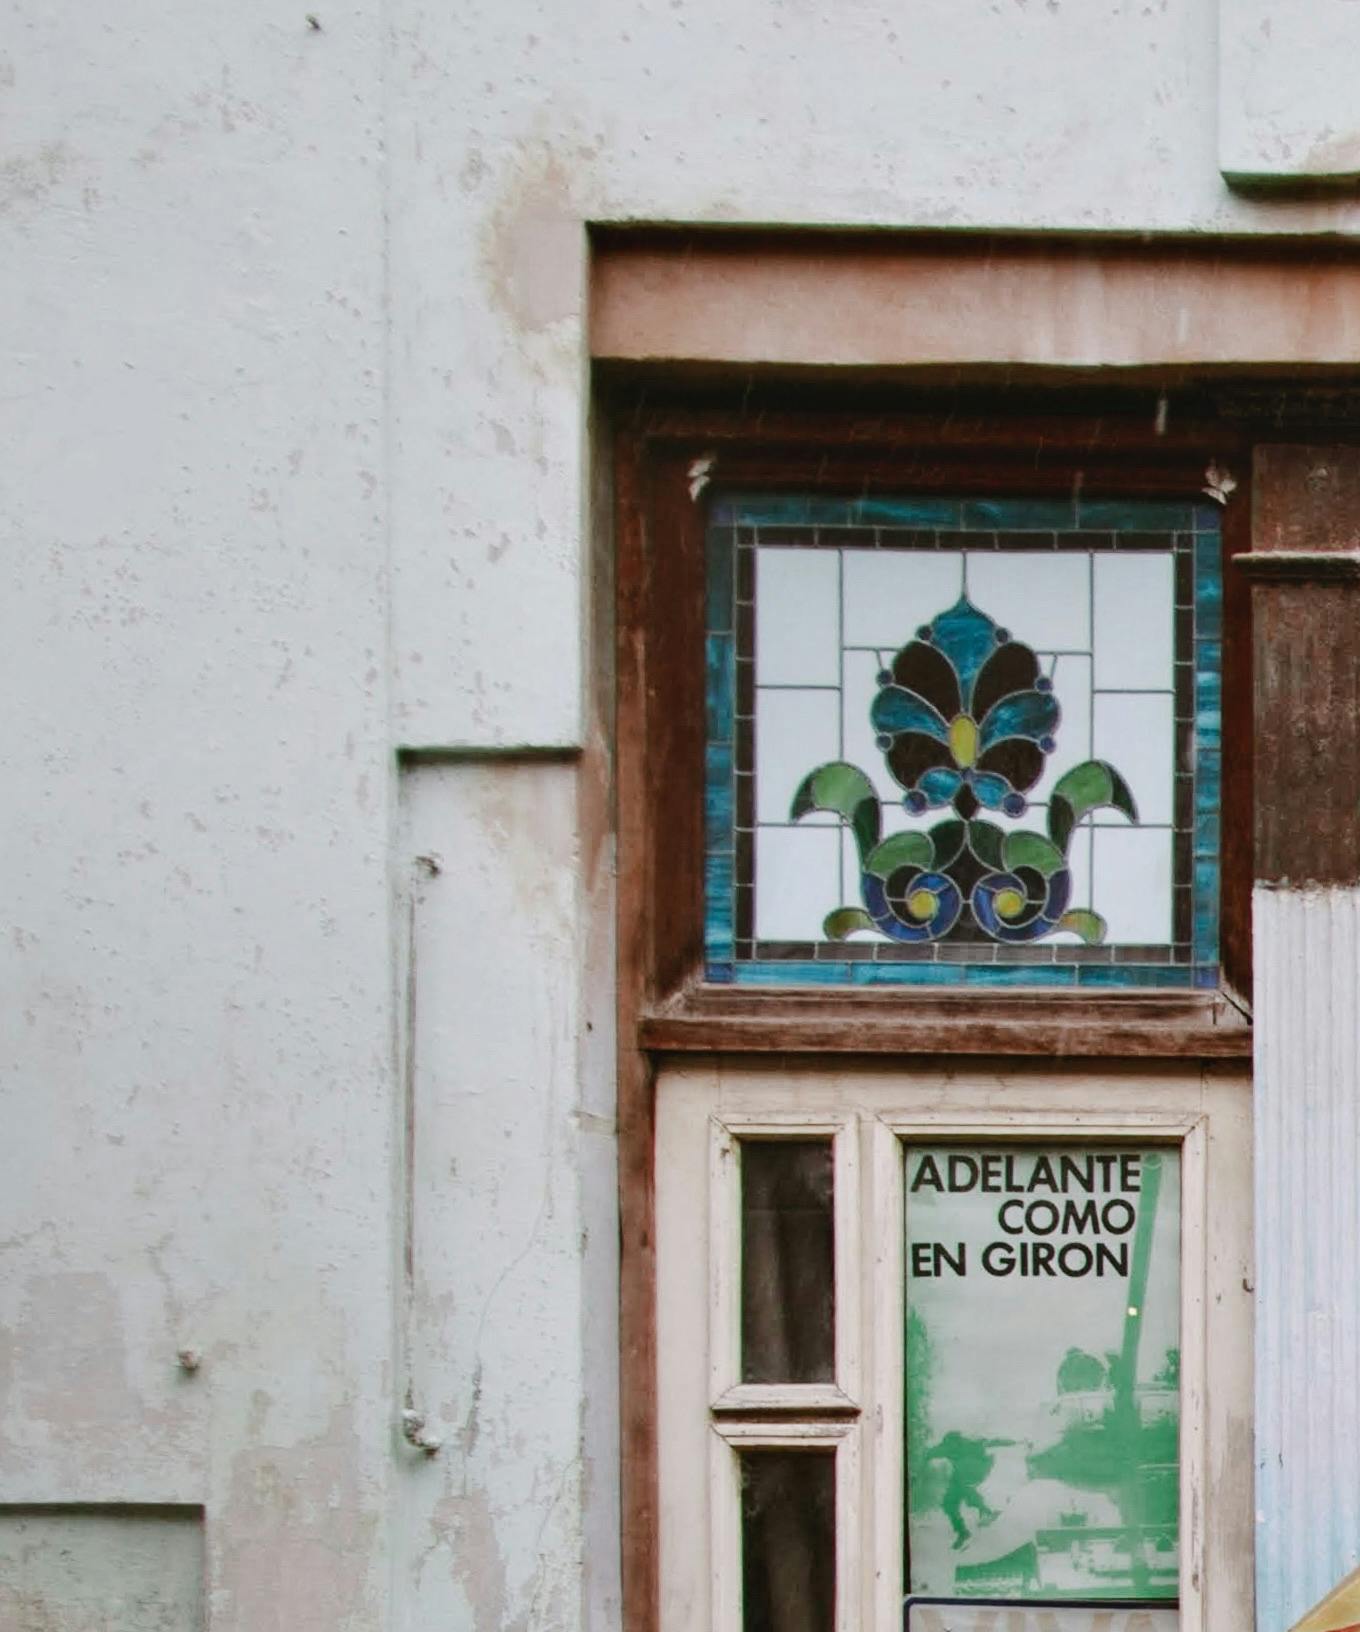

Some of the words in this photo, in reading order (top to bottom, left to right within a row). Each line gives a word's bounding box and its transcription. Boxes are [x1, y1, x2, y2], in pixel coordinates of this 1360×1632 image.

[910, 1154, 1141, 1193] ADELANTE
[999, 1199, 1136, 1236] COMO
[912, 1242, 966, 1277] EN
[982, 1242, 1129, 1278] GIRON
